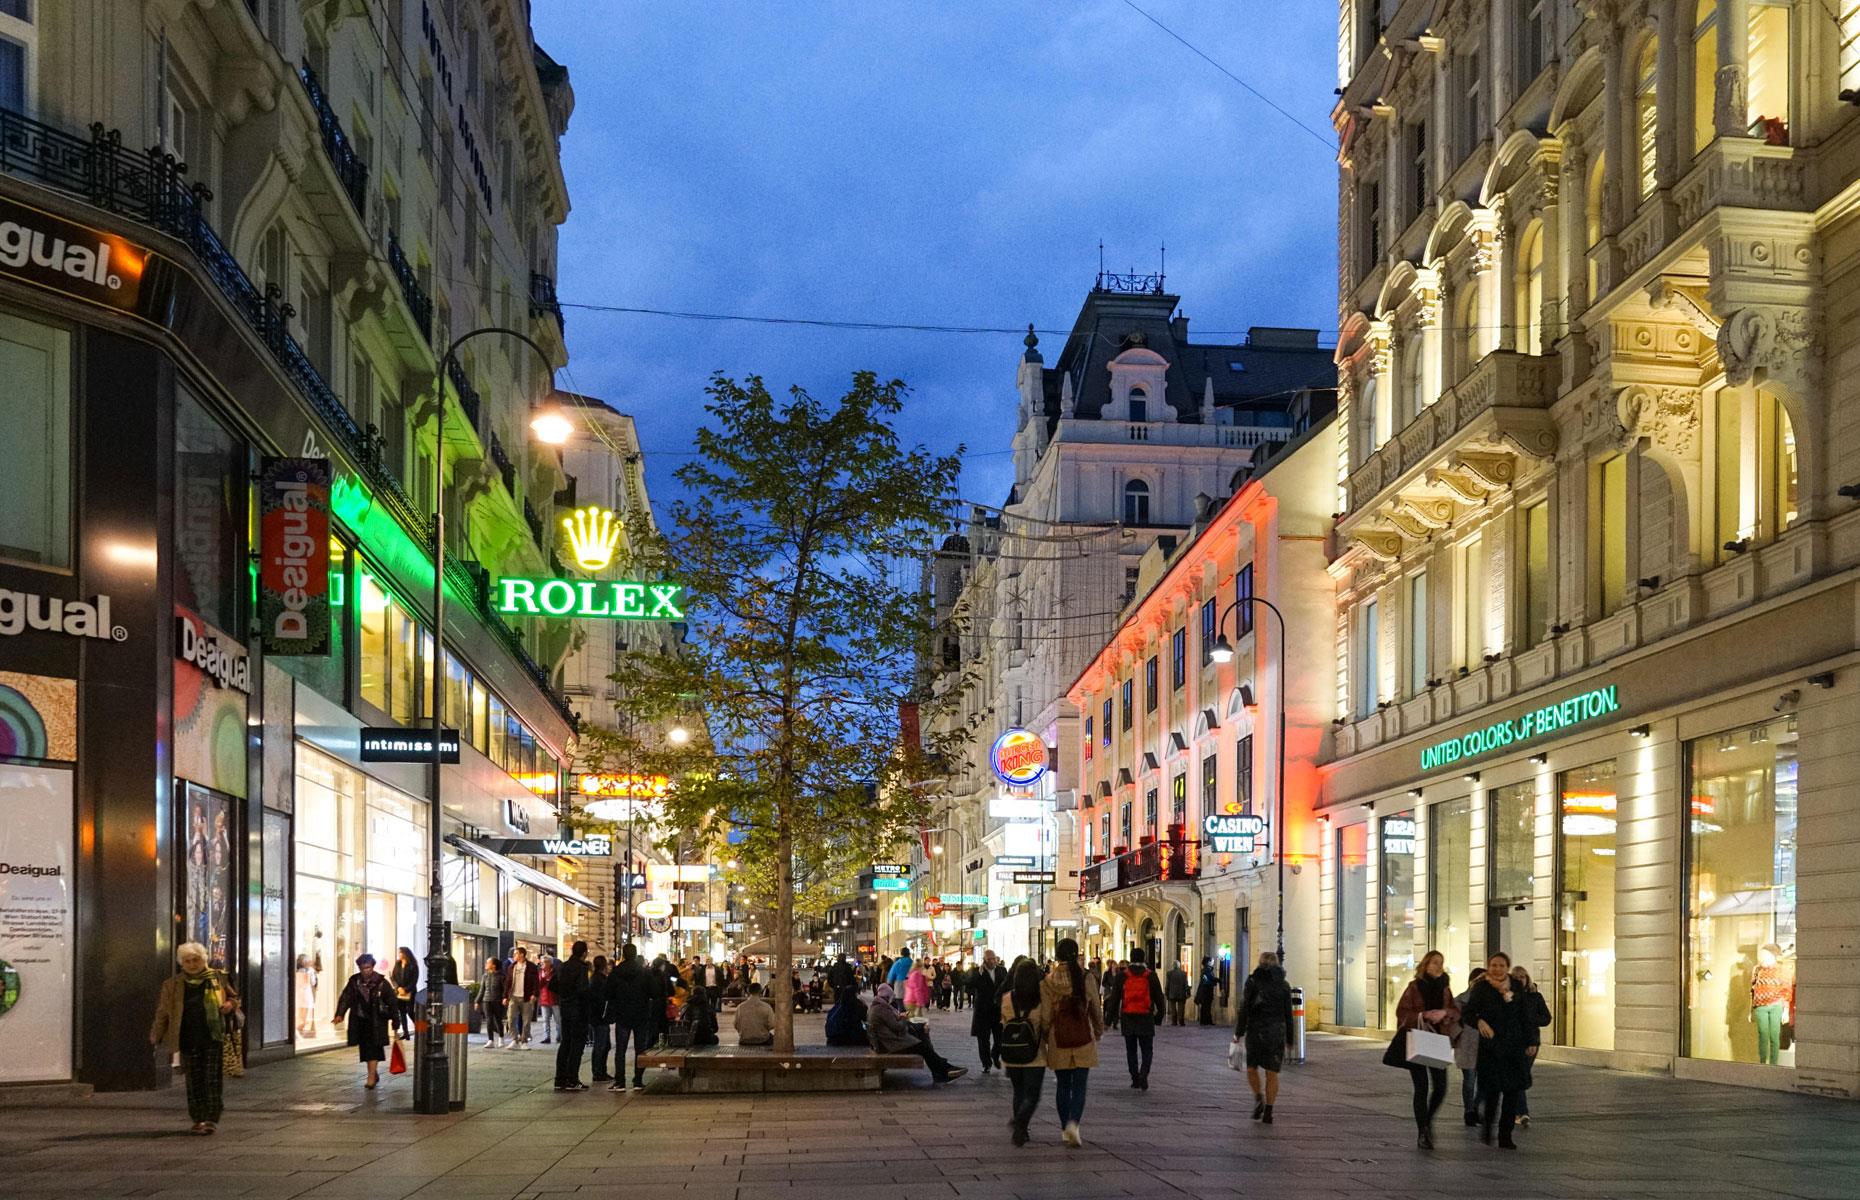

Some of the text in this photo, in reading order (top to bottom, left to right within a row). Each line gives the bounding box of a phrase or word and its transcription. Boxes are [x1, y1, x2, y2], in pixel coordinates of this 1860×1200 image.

[275, 481, 315, 639] Desigual
[499, 578, 684, 618] ROLEX
[183, 617, 250, 693] Desigual
[365, 739, 458, 752] intimissmi
[1000, 739, 1041, 758] BURGER
[1420, 738, 1462, 770] UNITED
[1462, 720, 1514, 757] COLORS
[1514, 713, 1535, 741] OF
[1001, 750, 1043, 773] KING
[543, 839, 611, 855] WAGNER
[1214, 836, 1254, 852] WIEN
[0, 863, 61, 878] Desigual
